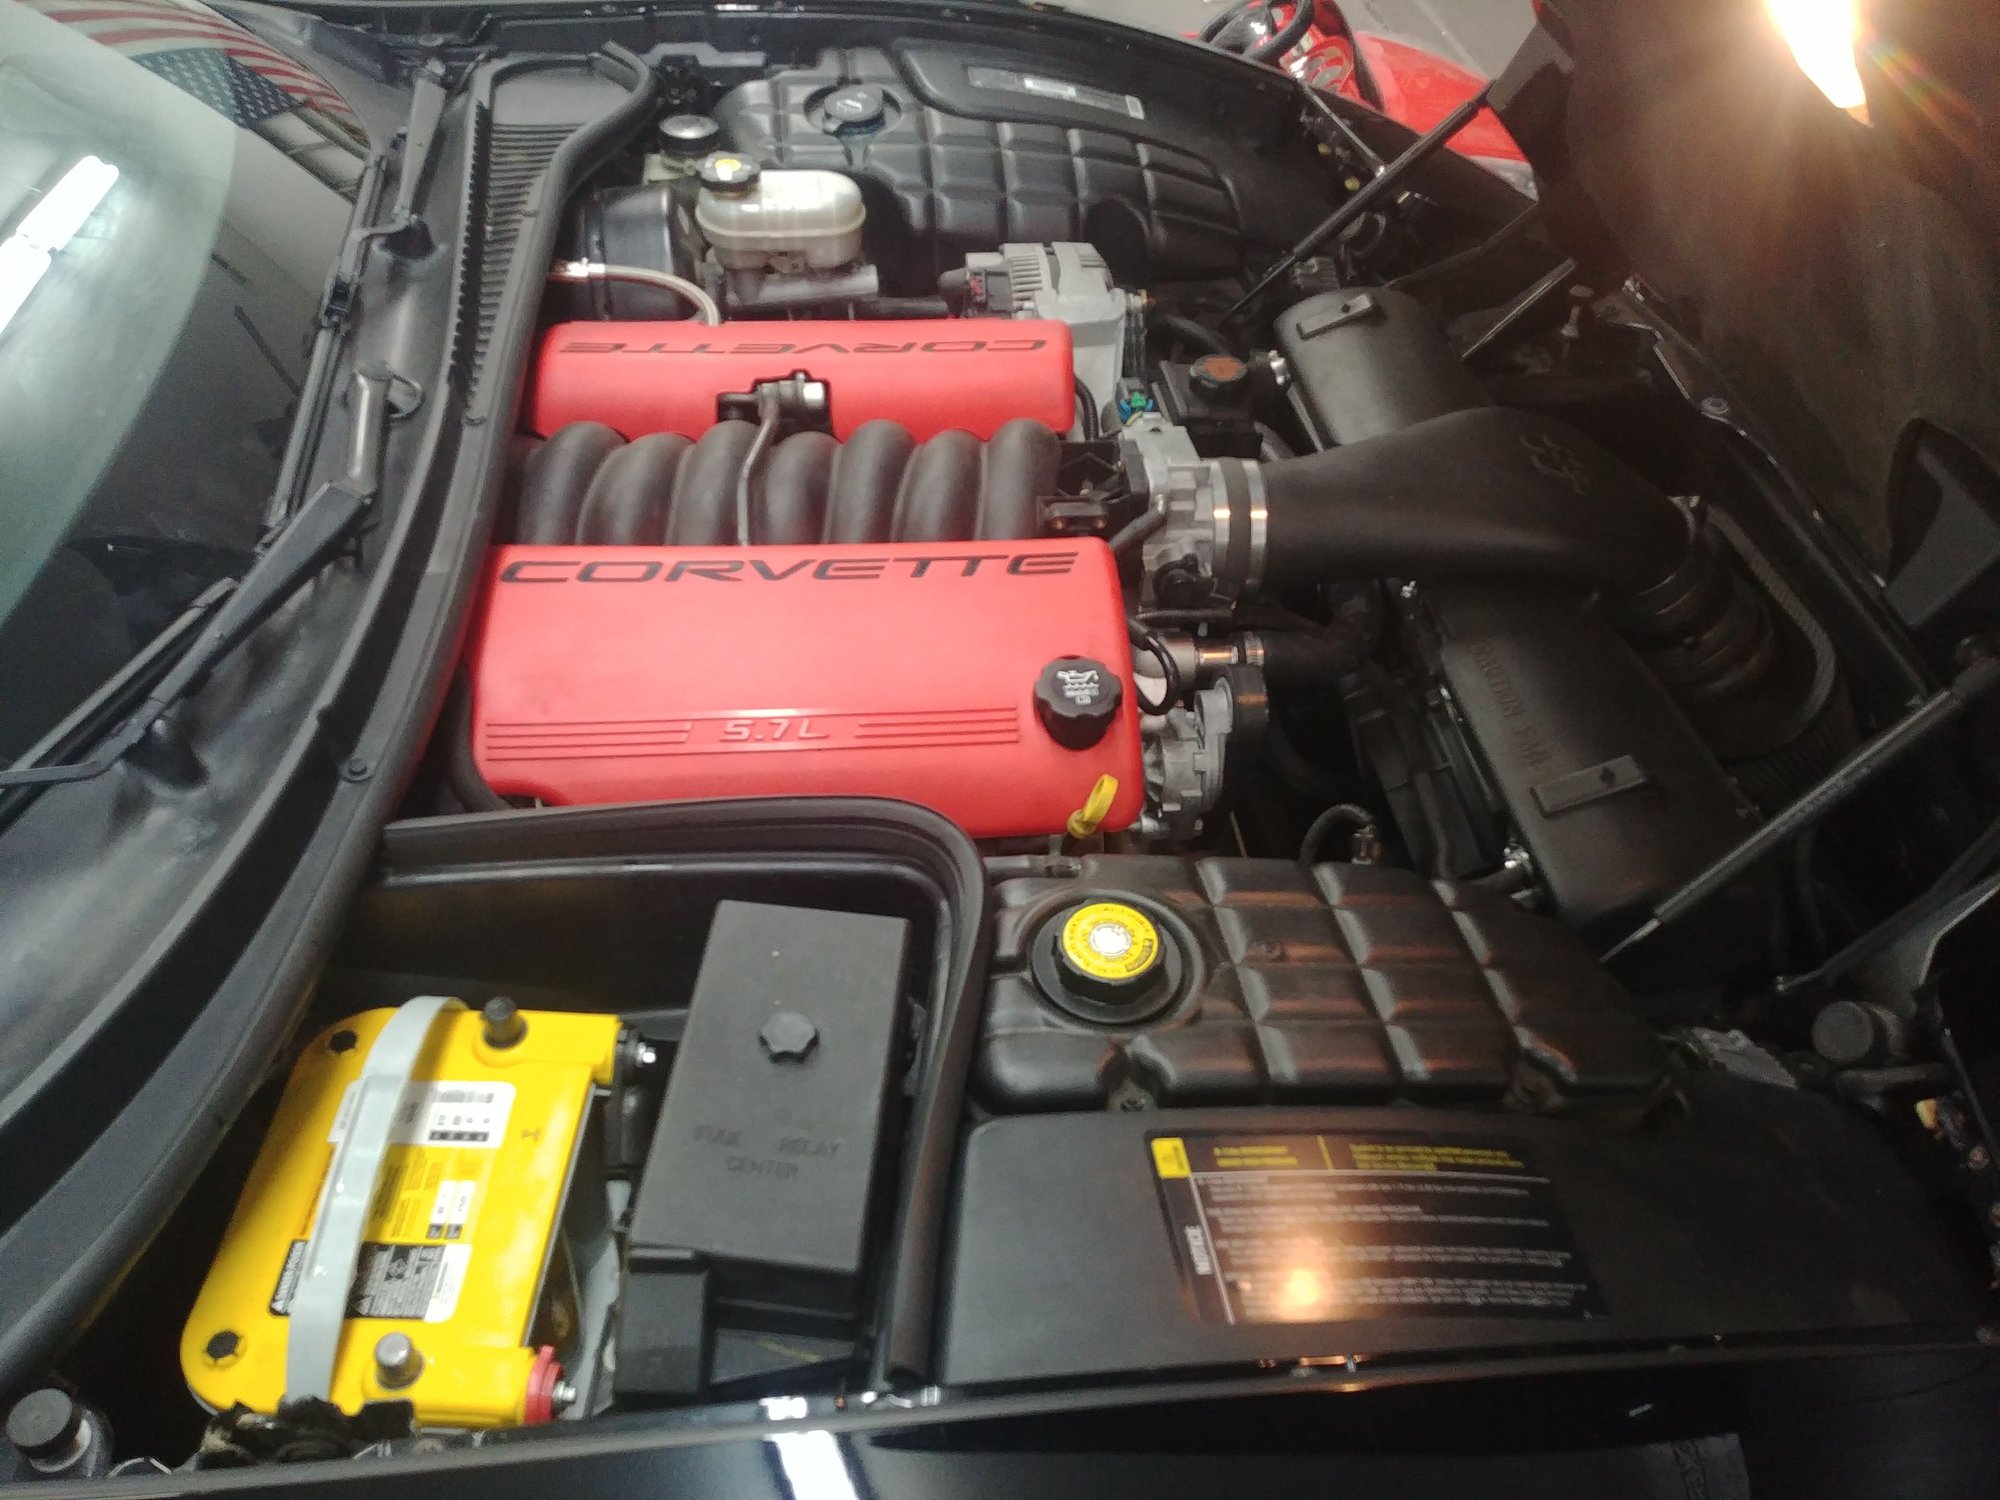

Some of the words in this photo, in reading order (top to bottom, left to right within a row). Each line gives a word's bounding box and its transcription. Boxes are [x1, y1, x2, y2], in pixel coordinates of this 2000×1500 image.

[560, 338, 1047, 356] CORVETTE
[499, 551, 1079, 584] CORVETTE
[720, 717, 829, 743] 5.7L
